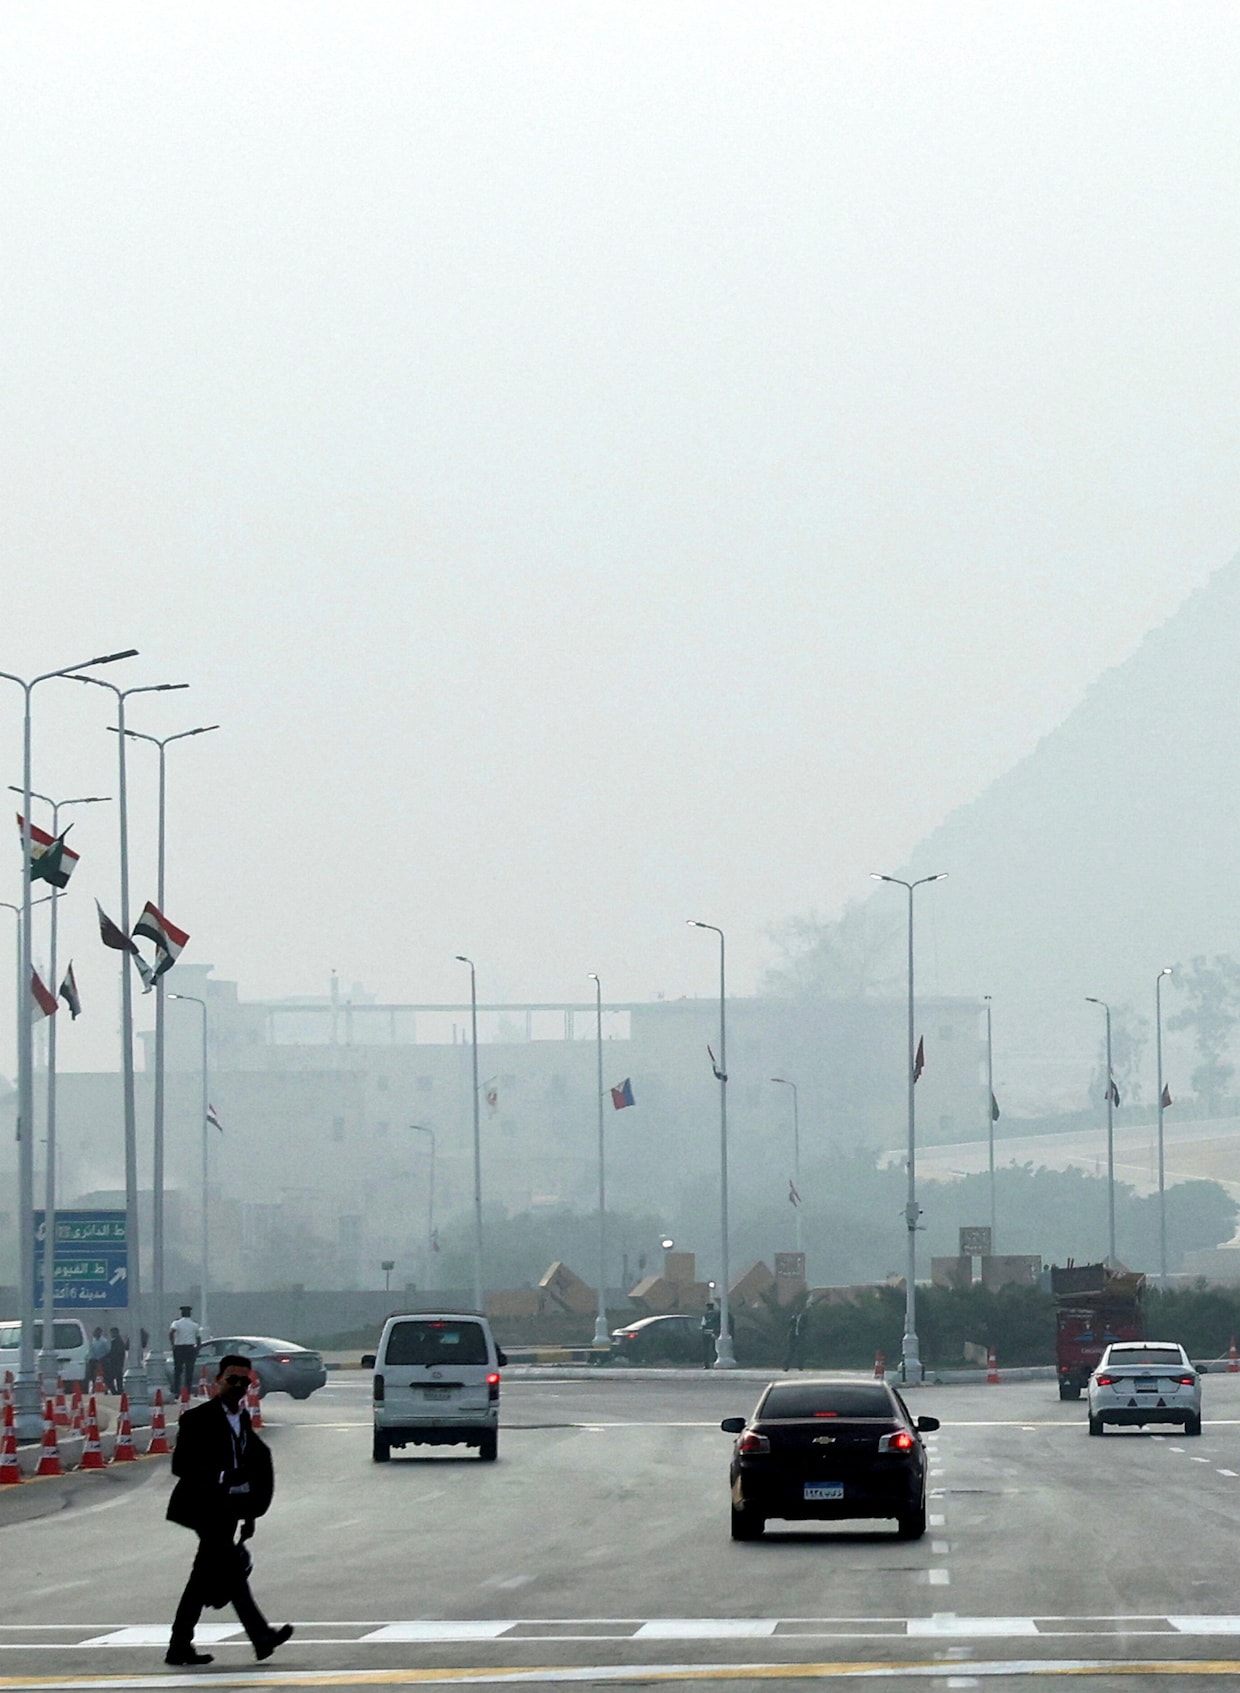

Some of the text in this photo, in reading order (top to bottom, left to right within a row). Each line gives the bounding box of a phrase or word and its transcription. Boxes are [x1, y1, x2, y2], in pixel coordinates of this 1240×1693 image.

[113, 1224, 125, 1236] ط
[95, 1263, 105, 1274] ط
[79, 1287, 107, 1301] مدينة
